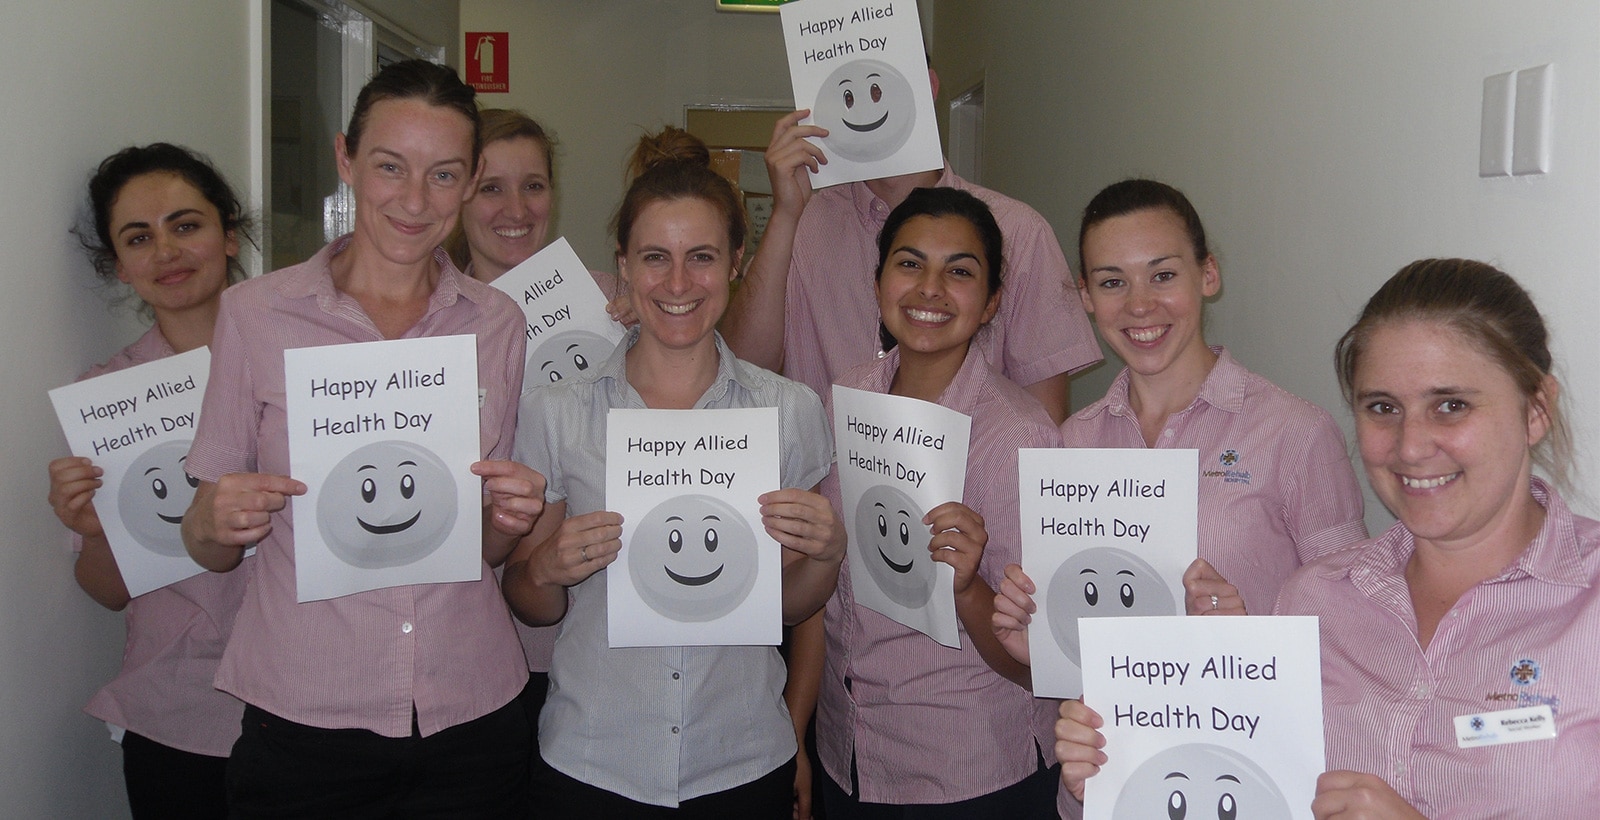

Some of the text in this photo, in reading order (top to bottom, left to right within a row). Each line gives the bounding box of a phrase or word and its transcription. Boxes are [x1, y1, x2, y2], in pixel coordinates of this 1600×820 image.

[799, 2, 894, 37] Happy Allied
[803, 36, 887, 65] Health Day
[524, 269, 564, 306] Allied
[541, 304, 571, 328] Day
[79, 375, 196, 424] Happy Allied
[311, 366, 445, 401] Happy Allied
[92, 411, 195, 457] Health Day
[313, 411, 433, 437] Health Day
[847, 414, 946, 451] Happy Allied
[627, 434, 748, 457] Happy Allied
[627, 468, 736, 490] Health Day
[848, 449, 927, 489] Health Day
[1040, 478, 1166, 503] Happy Allied
[1041, 516, 1151, 544] Health Day
[1110, 654, 1277, 686] Happy Allied
[1114, 703, 1261, 740] Health Day
[1500, 718, 1528, 726] Rebecca
